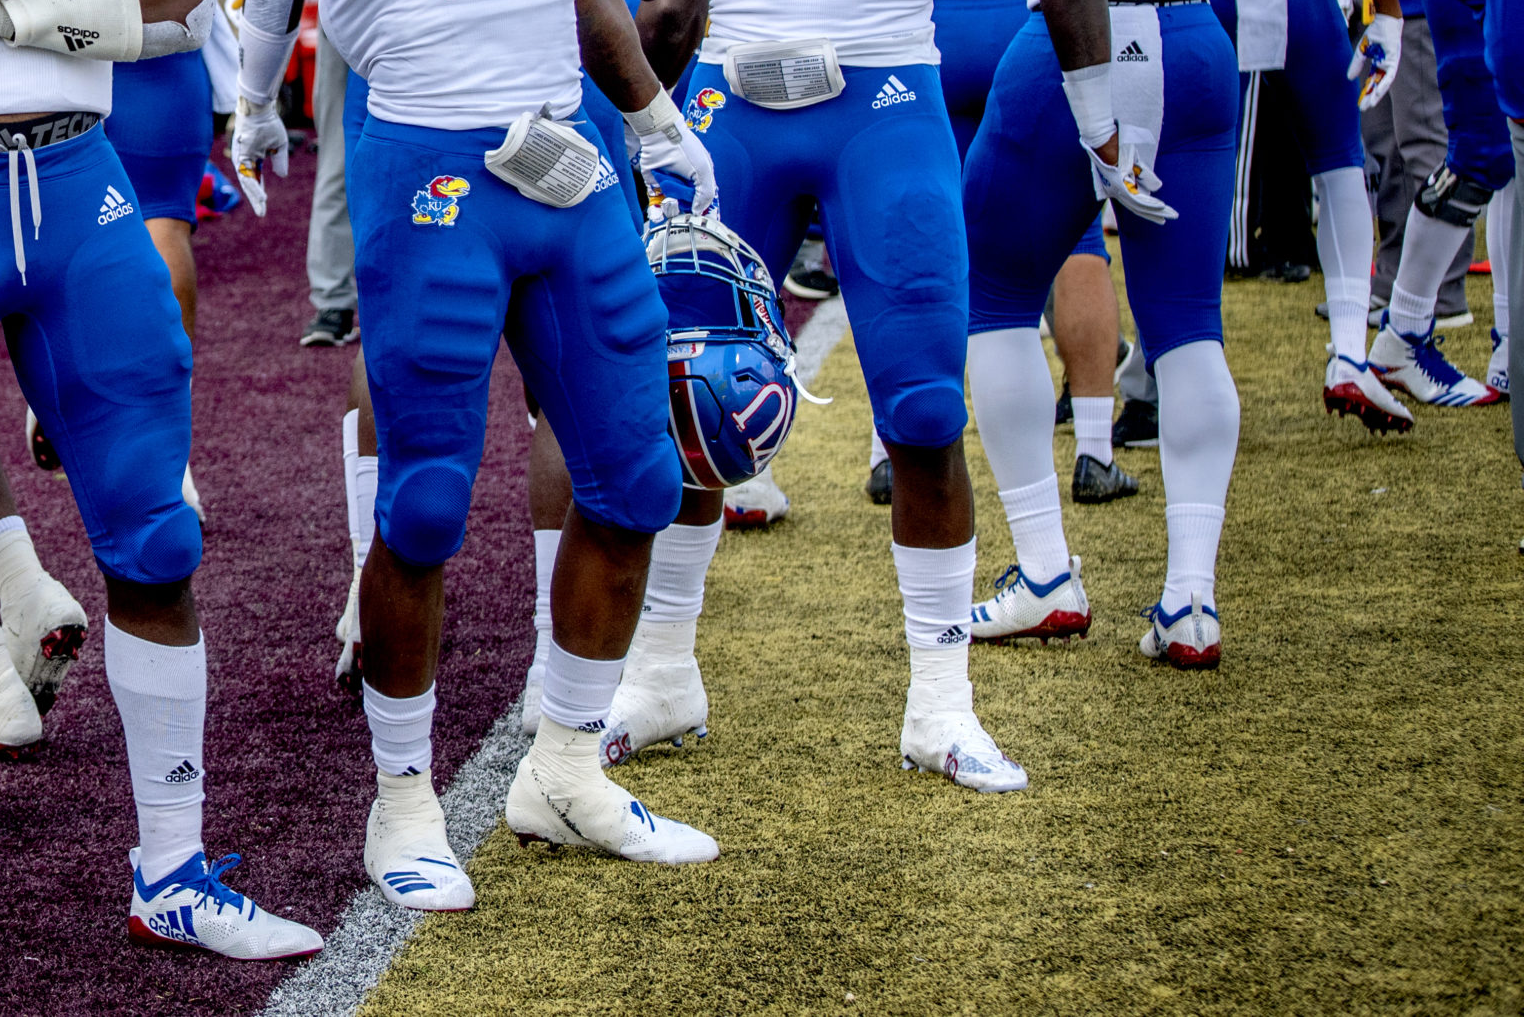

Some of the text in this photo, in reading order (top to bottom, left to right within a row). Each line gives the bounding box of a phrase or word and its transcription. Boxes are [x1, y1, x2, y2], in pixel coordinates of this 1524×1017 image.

[56, 25, 100, 39] adidas
[1116, 53, 1149, 63] adidas
[871, 91, 917, 109] adidas
[428, 201, 442, 212] KU
[97, 202, 135, 226] adidas
[936, 634, 968, 644] adidas
